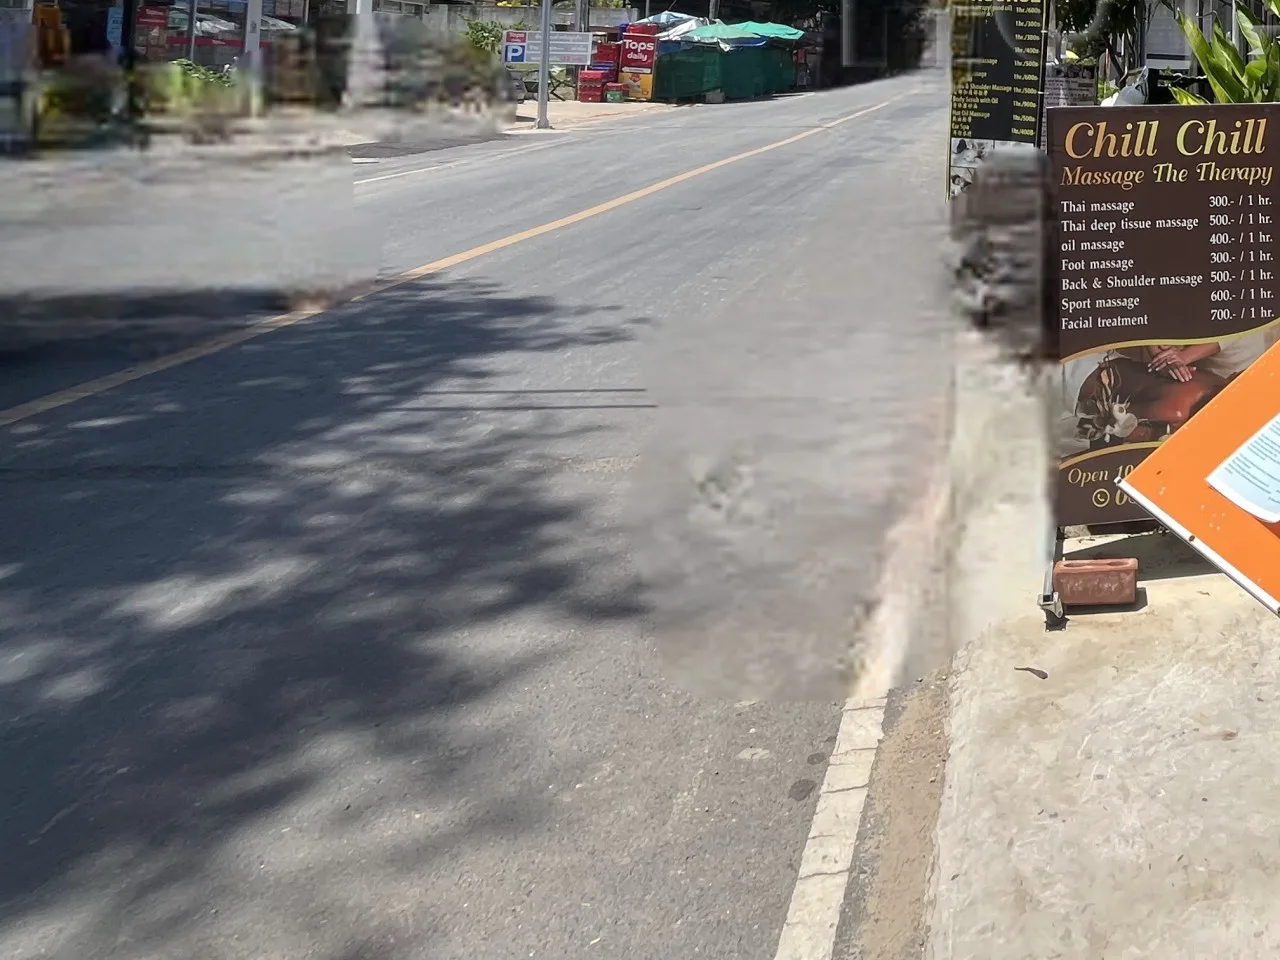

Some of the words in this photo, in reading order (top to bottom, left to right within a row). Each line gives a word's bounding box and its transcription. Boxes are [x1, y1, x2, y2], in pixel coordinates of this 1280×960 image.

[623, 40, 655, 52] Tops
[627, 52, 648, 62] daily
[1064, 120, 1159, 159] Chill
[1176, 118, 1267, 156] Chill
[1059, 165, 1145, 190] Massage
[1153, 162, 1189, 183] The
[1196, 161, 1273, 187] Therapy
[1061, 200, 1086, 213] Thai
[1090, 201, 1135, 214] massage
[1209, 195, 1235, 208] 300.-
[1238, 194, 1243, 206] /
[1247, 195, 1254, 206] 1
[1258, 194, 1272, 206] hr.
[1061, 220, 1086, 232] Thai
[1090, 219, 1116, 234] deep
[1121, 218, 1152, 230] tissue
[1156, 218, 1199, 231] massage
[1209, 214, 1235, 226] 500.-
[1239, 213, 1244, 225] /
[1248, 213, 1254, 224] 1
[1258, 212, 1273, 224] hr.
[1061, 239, 1076, 252] oil
[1080, 240, 1125, 253] massage
[1209, 232, 1236, 245] 400.-
[1239, 232, 1244, 244] /
[1248, 232, 1254, 243] 1
[1259, 231, 1273, 243] hr.
[1061, 259, 1086, 271] Foot
[1089, 258, 1134, 272] massage
[1210, 251, 1236, 264] 300.-
[1239, 250, 1244, 263] /
[1249, 250, 1254, 262] 1
[1259, 249, 1274, 262] hr.
[1061, 277, 1088, 291] Back
[1092, 277, 1102, 289] &
[1106, 275, 1156, 288] Shoulder
[1160, 274, 1203, 288] massage
[1210, 270, 1236, 283] 500.-
[1240, 269, 1245, 281] /
[1249, 269, 1255, 281] 1
[1259, 268, 1274, 280] hr.
[1061, 298, 1092, 313] Sport
[1095, 297, 1140, 310] massage
[1210, 289, 1236, 302] 600.-
[1240, 288, 1245, 300] /
[1249, 288, 1255, 300] 1
[1260, 287, 1274, 299] hr.
[1061, 316, 1093, 330] Facial
[1097, 314, 1148, 328] treatment
[1210, 308, 1237, 321] 700.-
[1240, 307, 1246, 320] /
[1250, 307, 1256, 319] 1
[1260, 306, 1275, 318] hr.
[1068, 467, 1109, 488] Open
